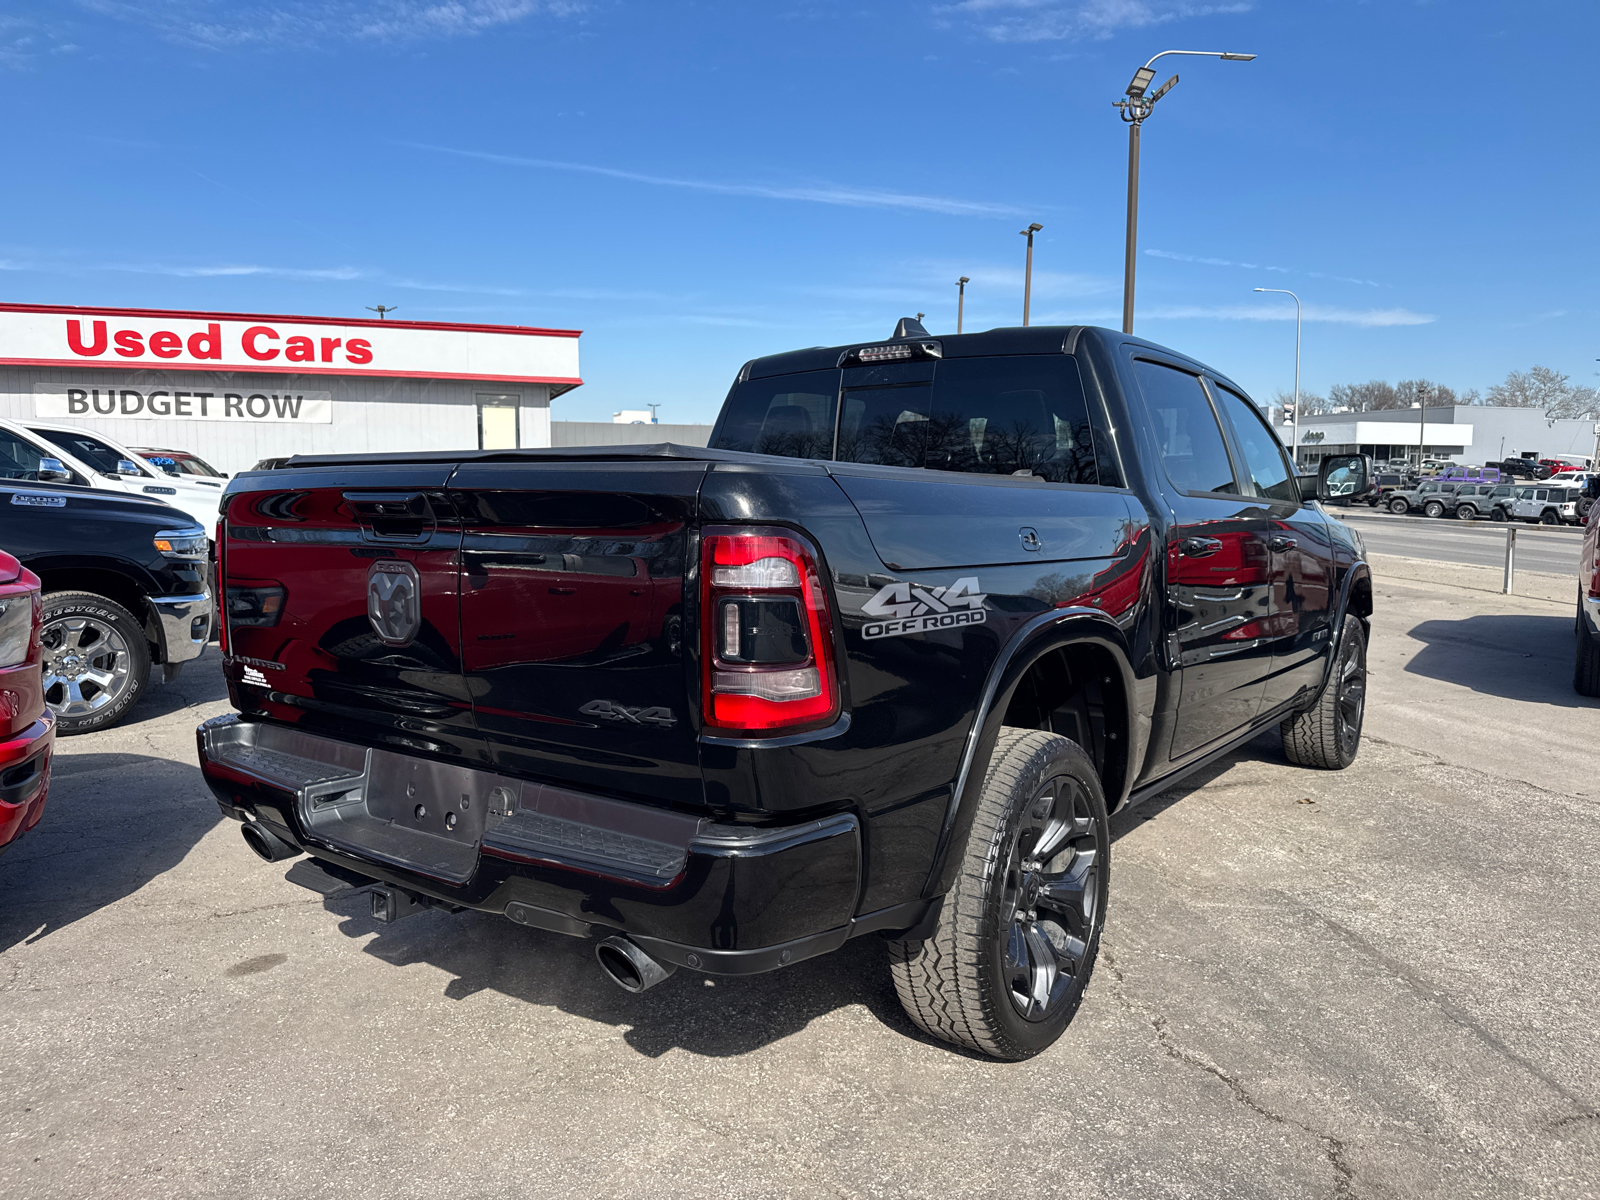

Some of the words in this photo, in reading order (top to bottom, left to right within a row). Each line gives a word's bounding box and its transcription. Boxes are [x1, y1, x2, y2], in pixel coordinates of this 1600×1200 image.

[66, 319, 222, 361] Used
[241, 326, 374, 365] Cars
[67, 388, 214, 417] BUDGET
[224, 393, 304, 420] ROW
[375, 563, 407, 573] RAM
[864, 618, 919, 638] OFF
[922, 611, 985, 630] ROAD
